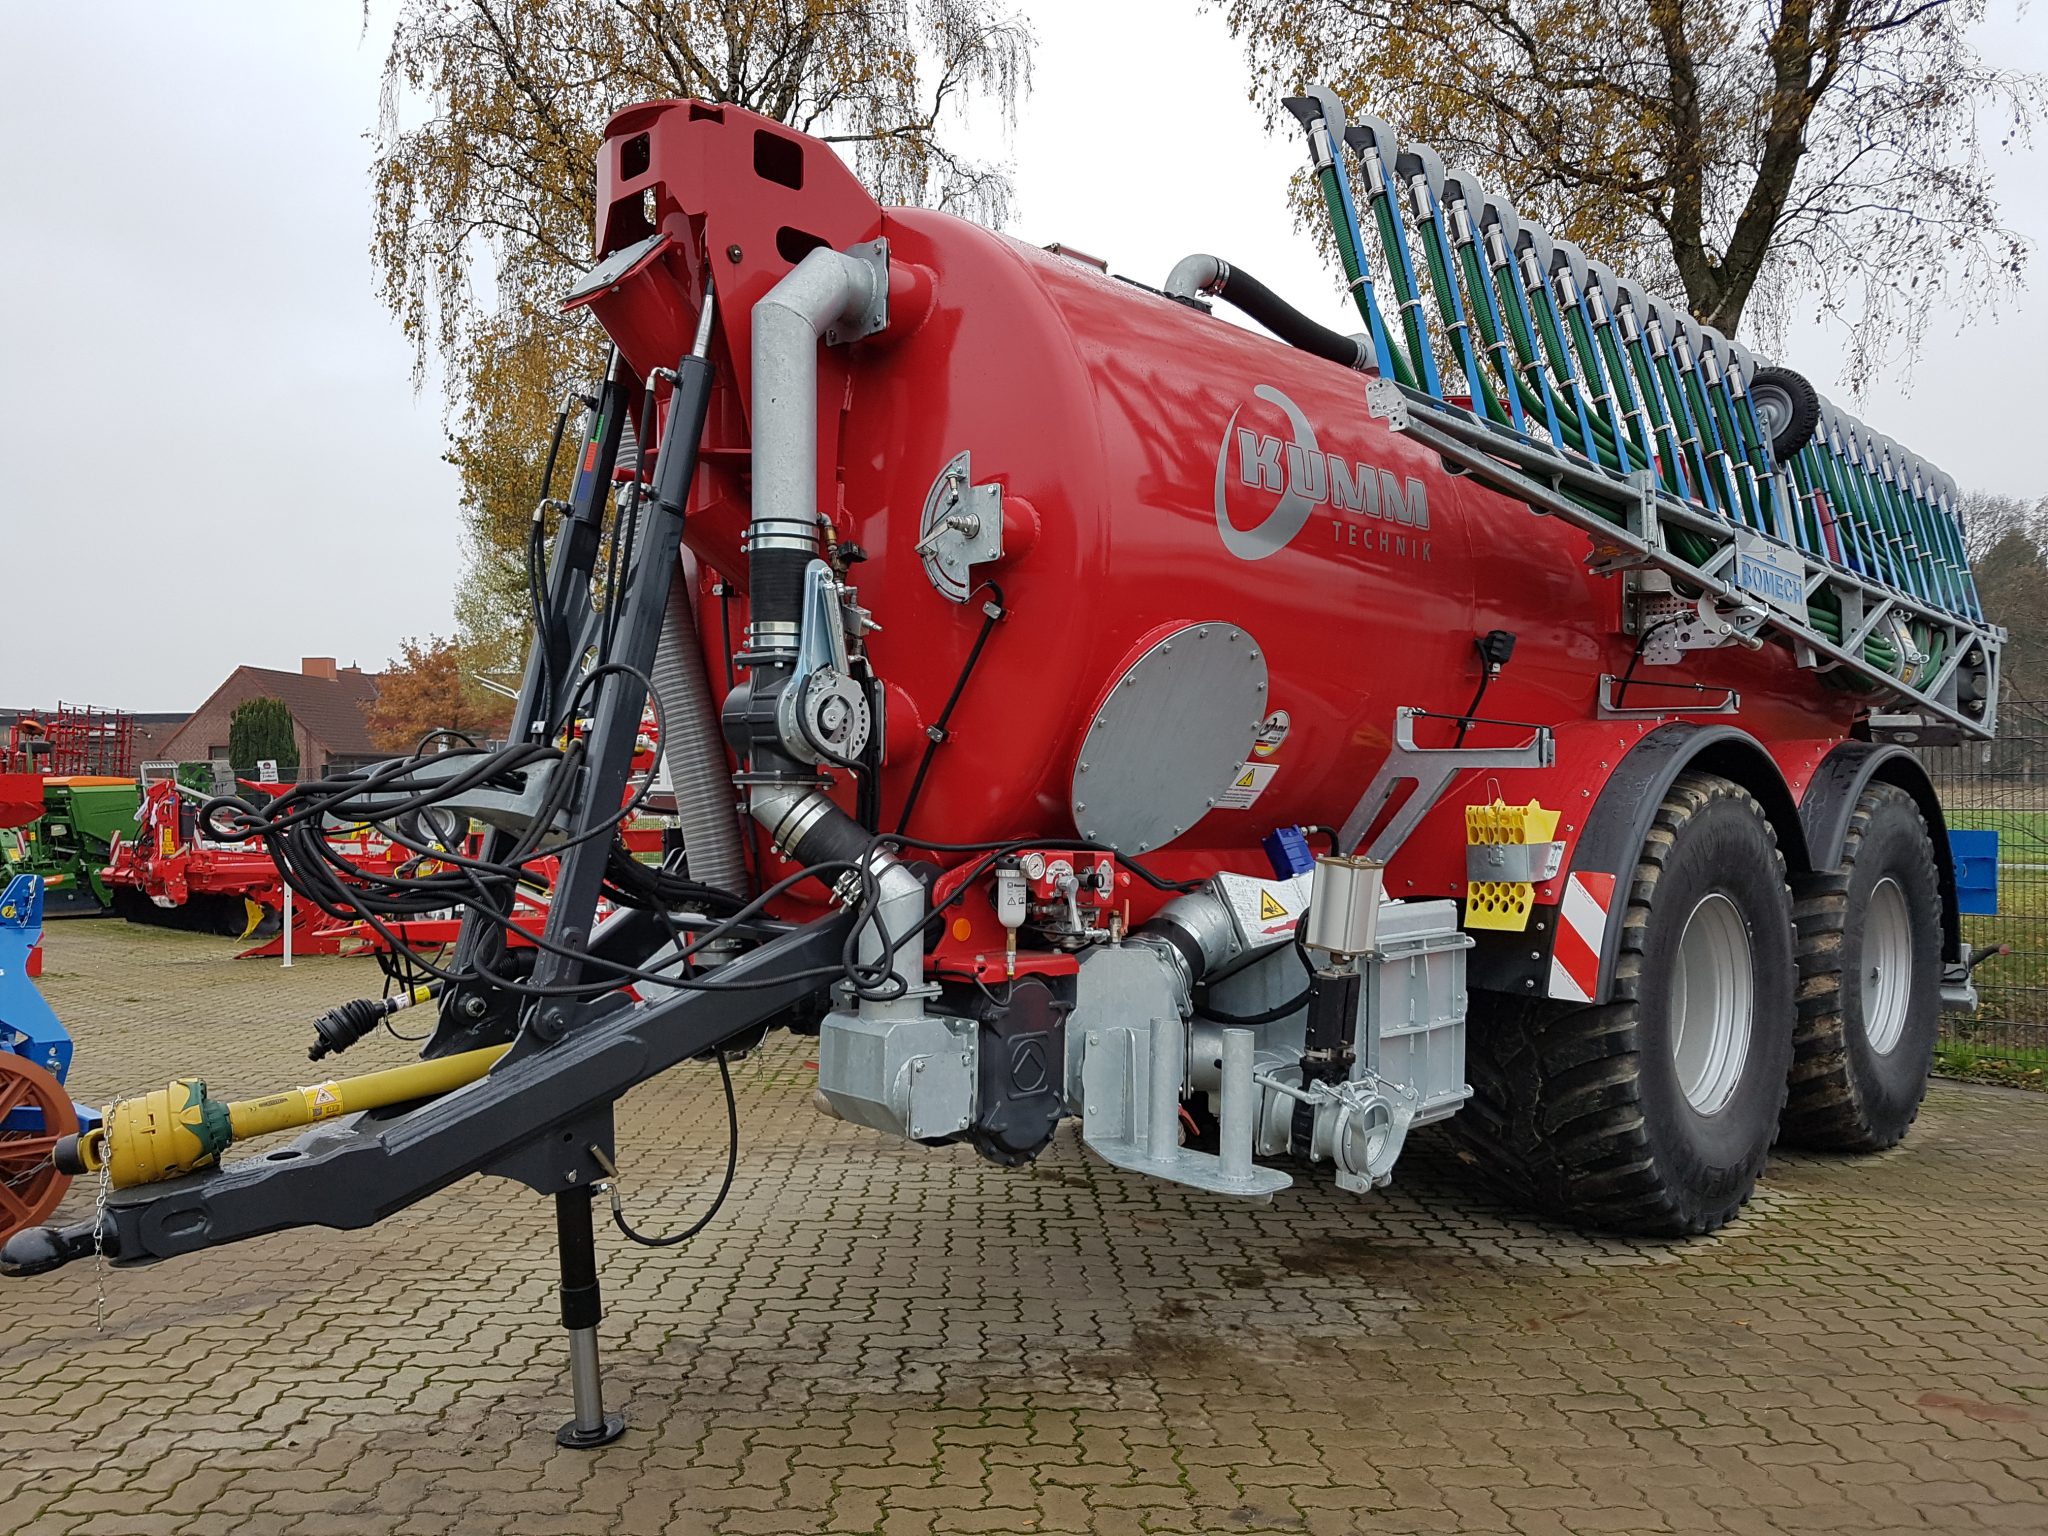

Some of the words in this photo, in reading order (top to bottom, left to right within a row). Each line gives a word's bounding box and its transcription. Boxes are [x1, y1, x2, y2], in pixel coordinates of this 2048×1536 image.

[1237, 427, 1430, 531] KUMM
[1332, 521, 1431, 562] TECHNIK
[1741, 562, 1803, 606] BOMECH
